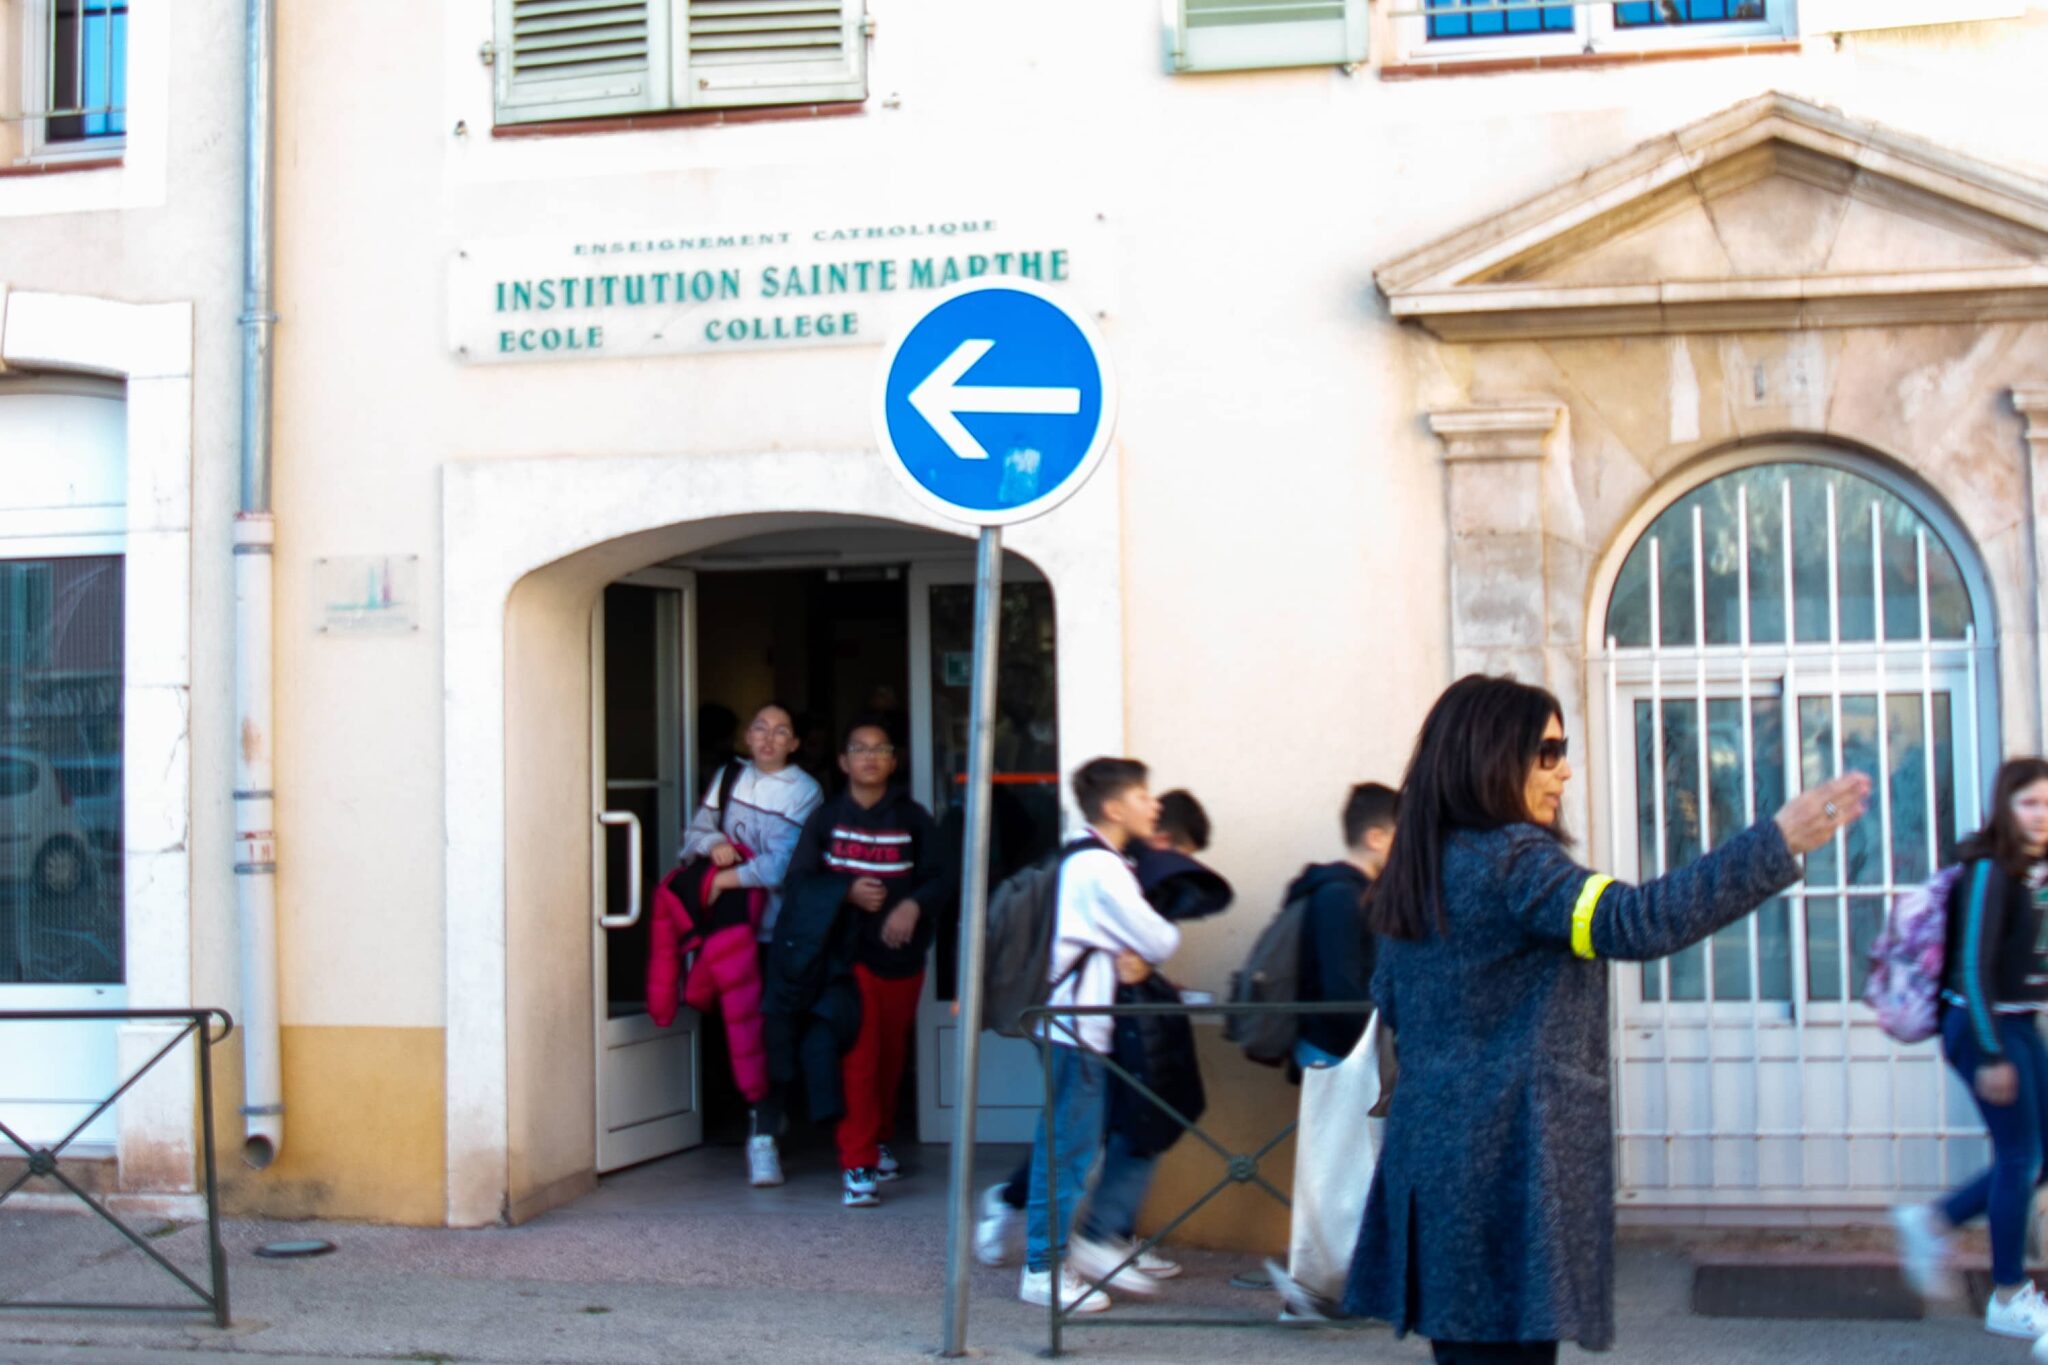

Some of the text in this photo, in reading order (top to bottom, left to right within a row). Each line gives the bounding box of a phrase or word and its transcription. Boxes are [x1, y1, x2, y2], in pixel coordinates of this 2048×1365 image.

[573, 219, 997, 256] ENSEIGNEMENT CATHOLIQUE
[496, 249, 1070, 312] INSTITUTION SAINTE MARTHE
[499, 326, 603, 353] ECOLE
[705, 312, 859, 343] COLLEGE
